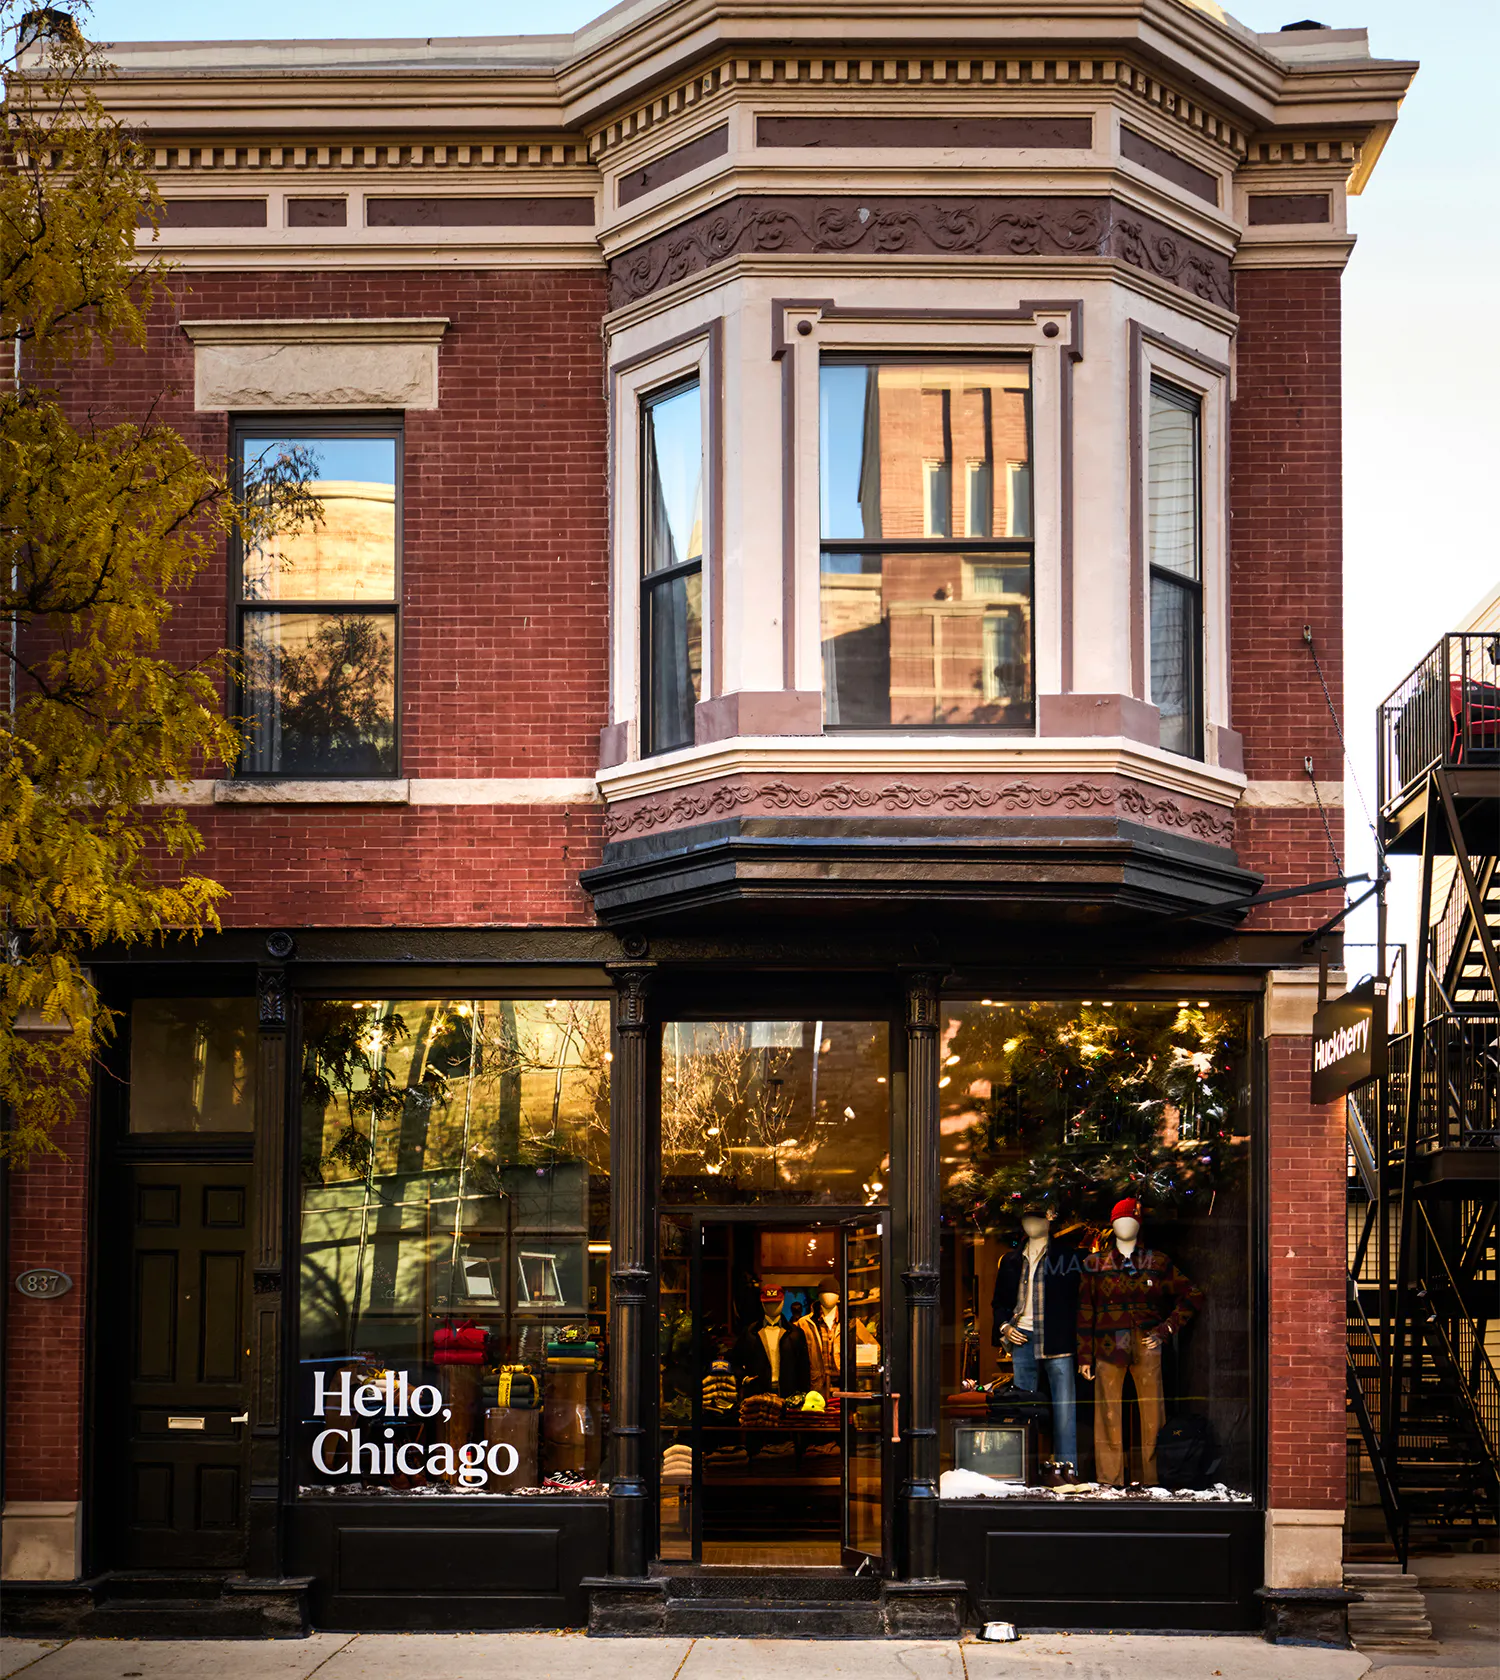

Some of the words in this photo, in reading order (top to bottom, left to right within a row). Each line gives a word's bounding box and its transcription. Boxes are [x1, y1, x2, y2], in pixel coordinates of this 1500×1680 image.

[1314, 1017, 1370, 1073] Huckberry
[27, 1275, 59, 1292] 837
[312, 1370, 452, 1424] Hello,
[312, 1428, 520, 1488] Chicago
